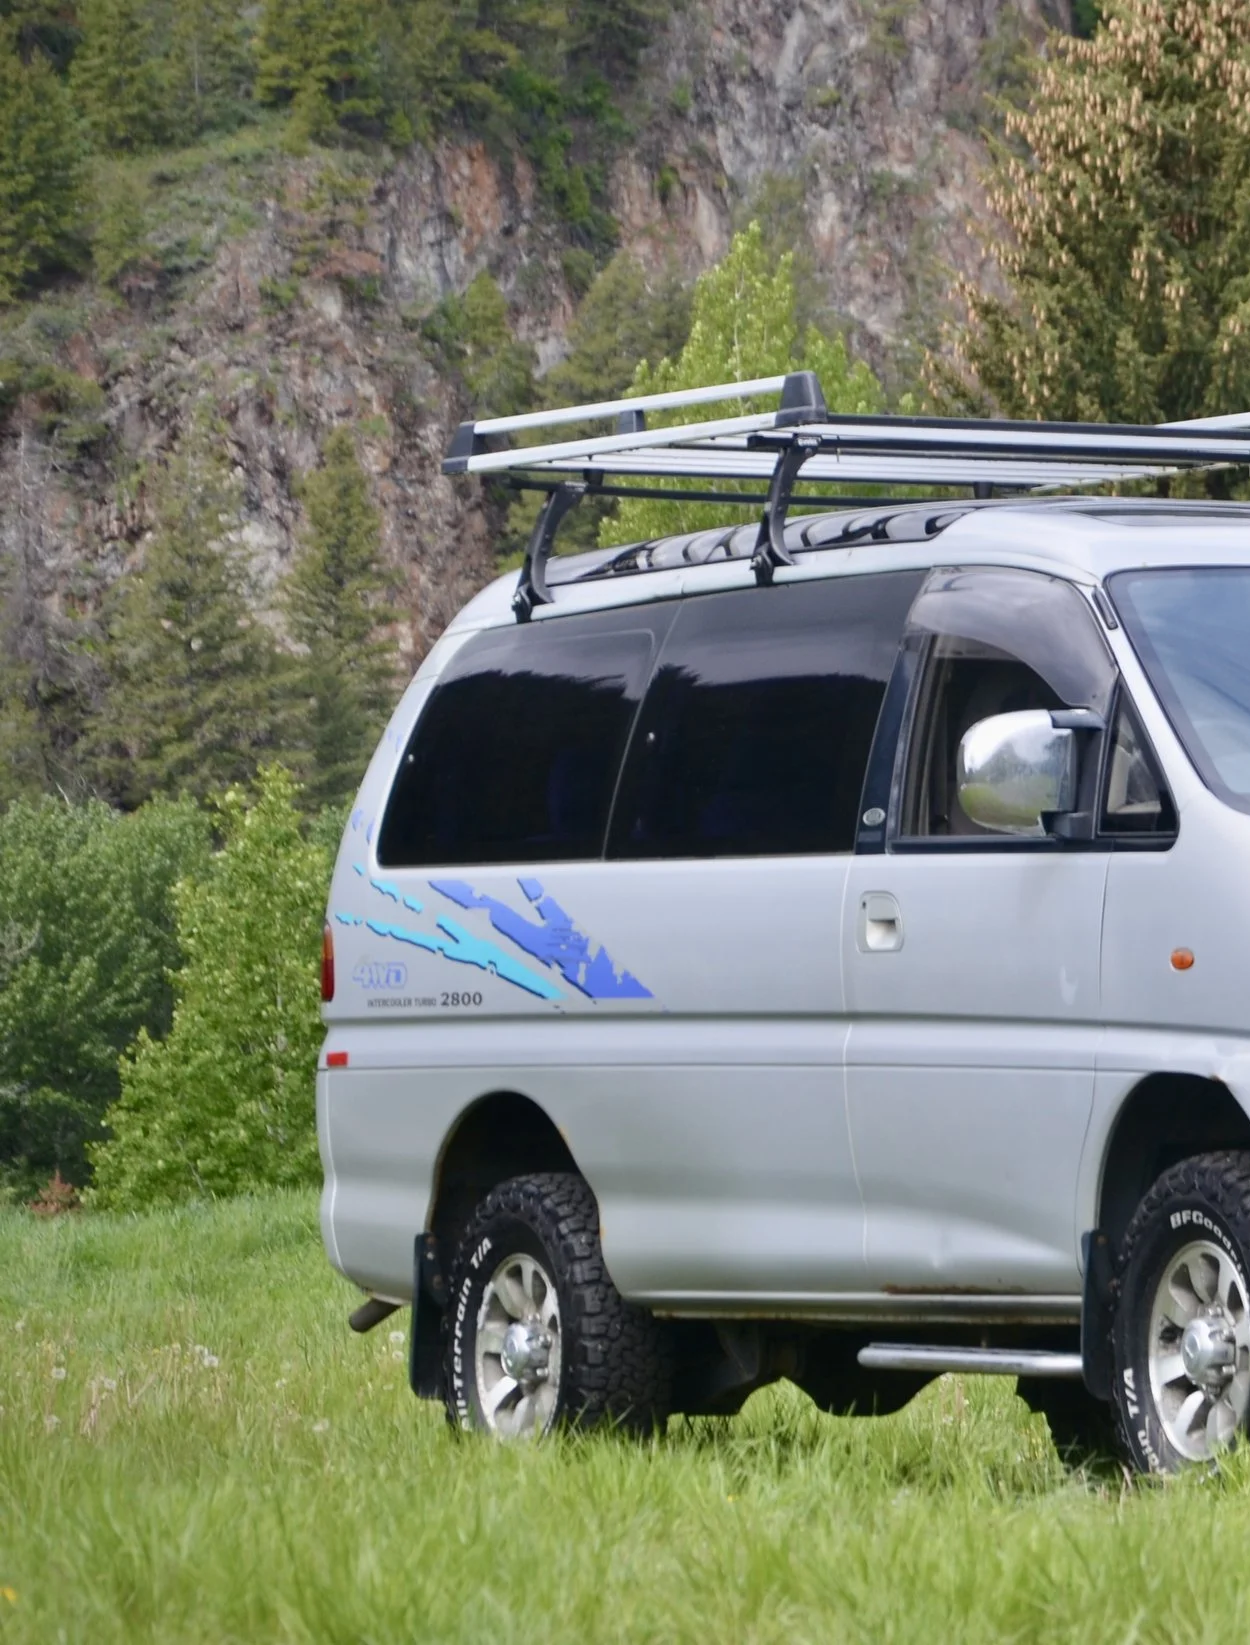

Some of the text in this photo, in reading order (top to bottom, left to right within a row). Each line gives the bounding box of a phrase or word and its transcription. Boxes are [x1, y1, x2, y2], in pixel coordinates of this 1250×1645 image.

[352, 960, 408, 990] 4WD
[367, 991, 483, 1008] INTERCOOLER TURBO 2800
[470, 1237, 492, 1269] T/A
[1169, 1209, 1250, 1303] BFGoodri
[1123, 1367, 1139, 1419] T/A
